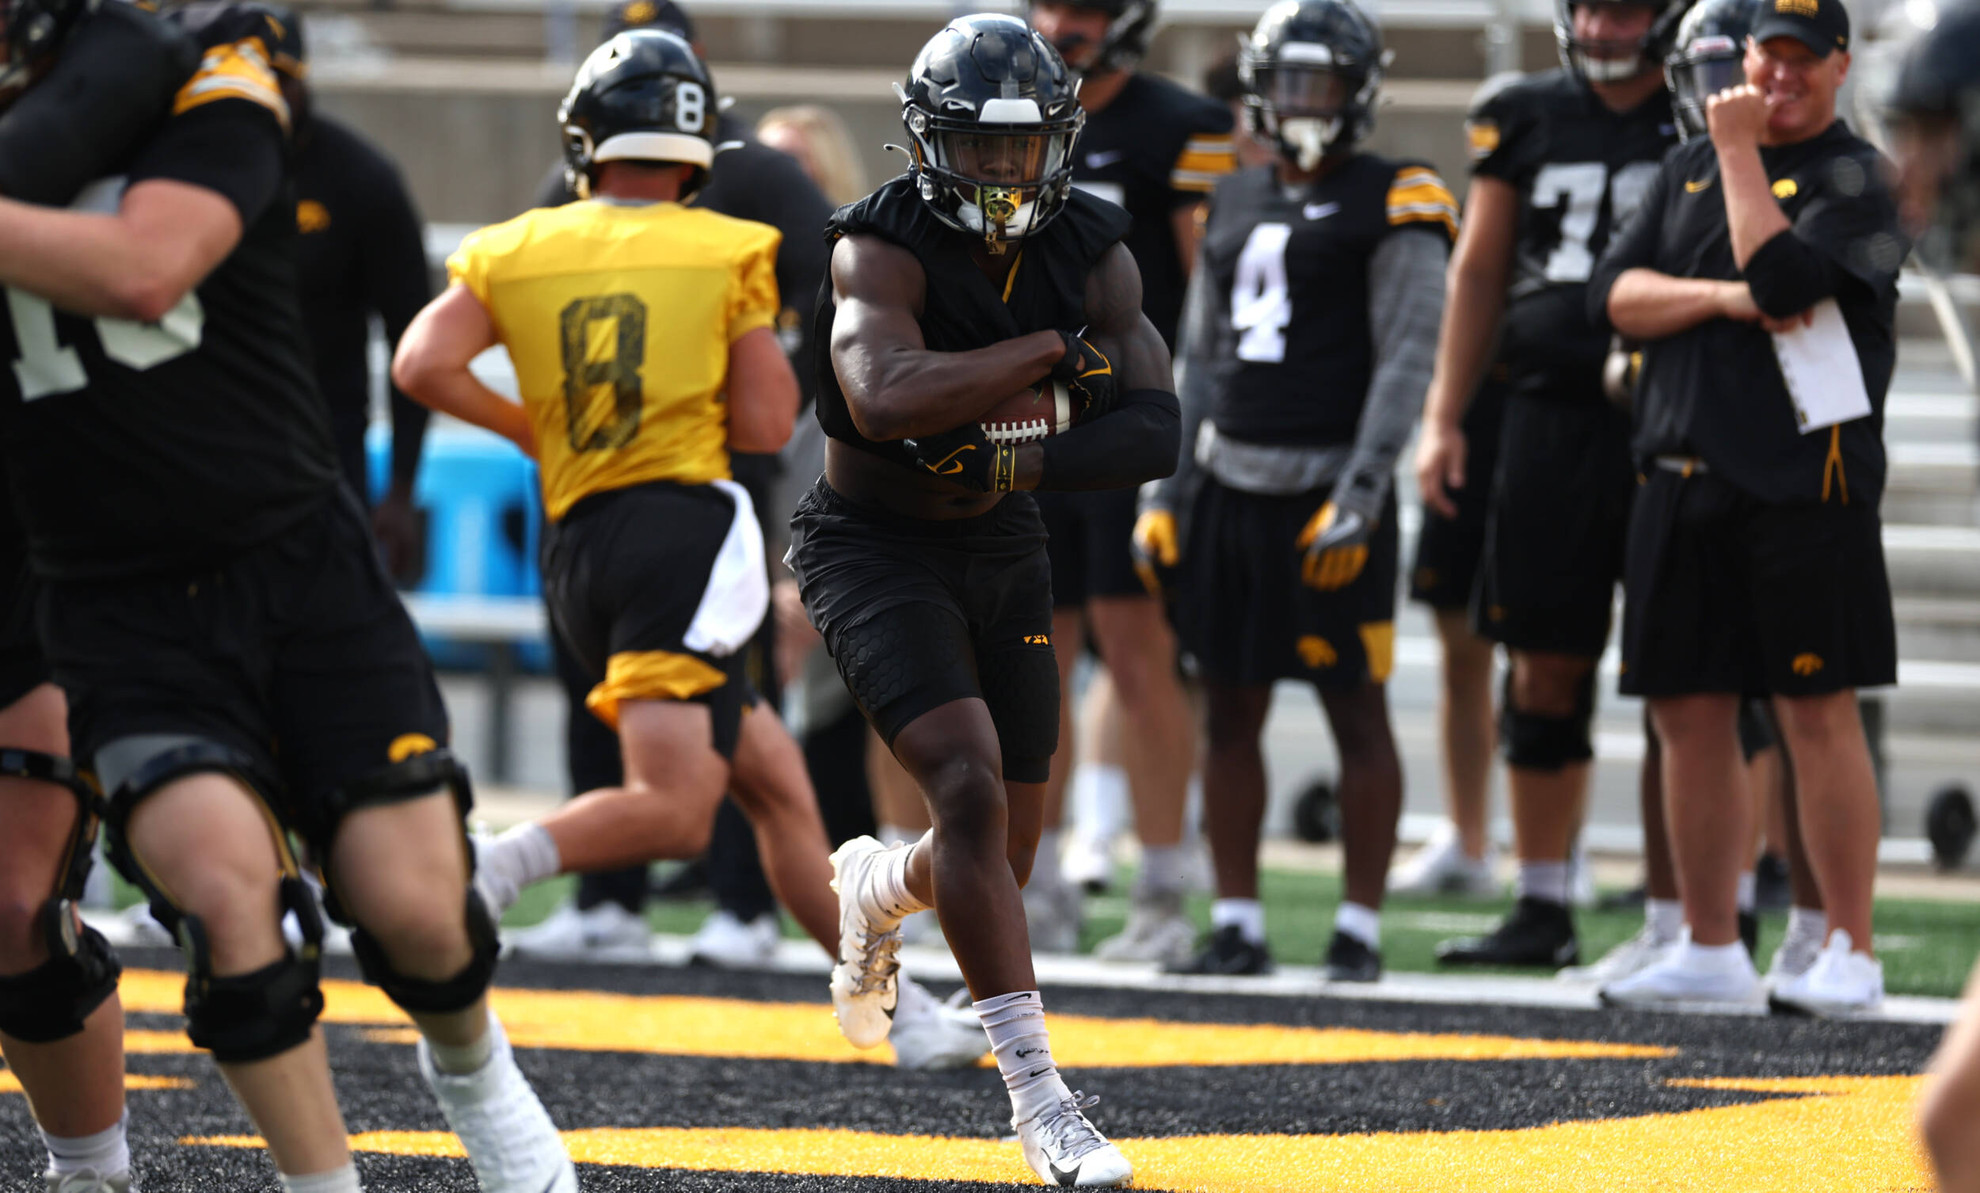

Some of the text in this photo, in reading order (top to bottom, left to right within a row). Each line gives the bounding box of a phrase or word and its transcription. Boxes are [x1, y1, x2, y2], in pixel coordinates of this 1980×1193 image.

[674, 82, 705, 132] 8
[1231, 222, 1292, 363] 4
[560, 293, 648, 453] 8
